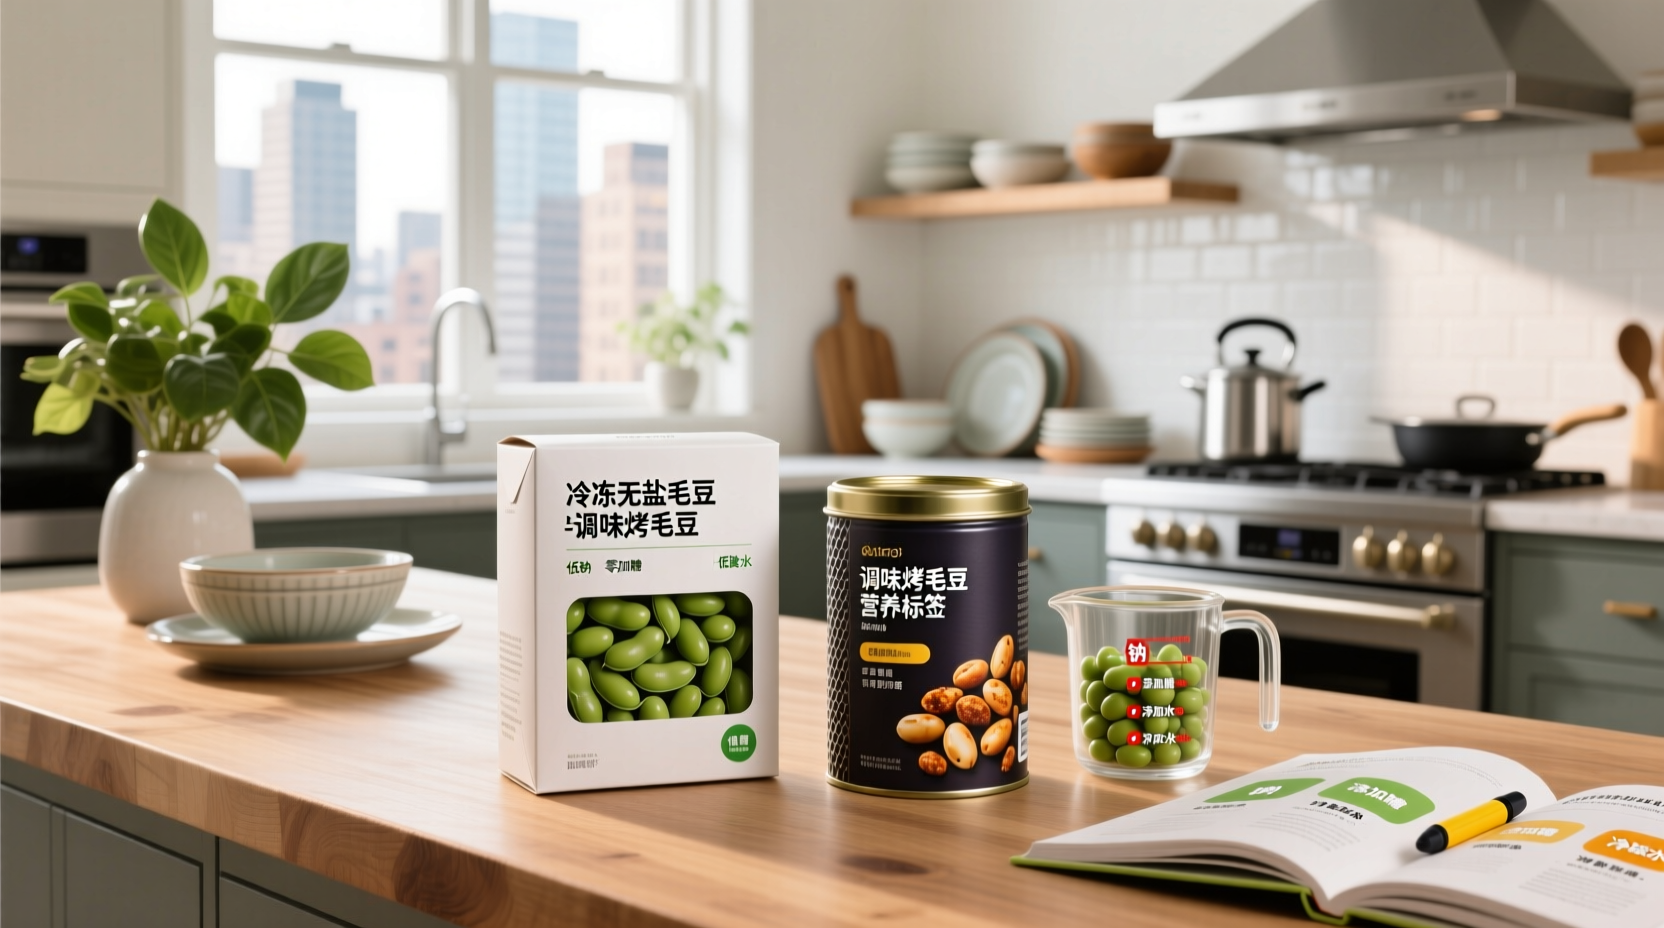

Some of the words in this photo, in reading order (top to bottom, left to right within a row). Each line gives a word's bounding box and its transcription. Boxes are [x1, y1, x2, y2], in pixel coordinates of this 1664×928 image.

[566, 479, 716, 508] 冷冻无盐毛豆
[860, 566, 968, 591] 调味烤毛豆
[861, 593, 946, 619] 营养标签
